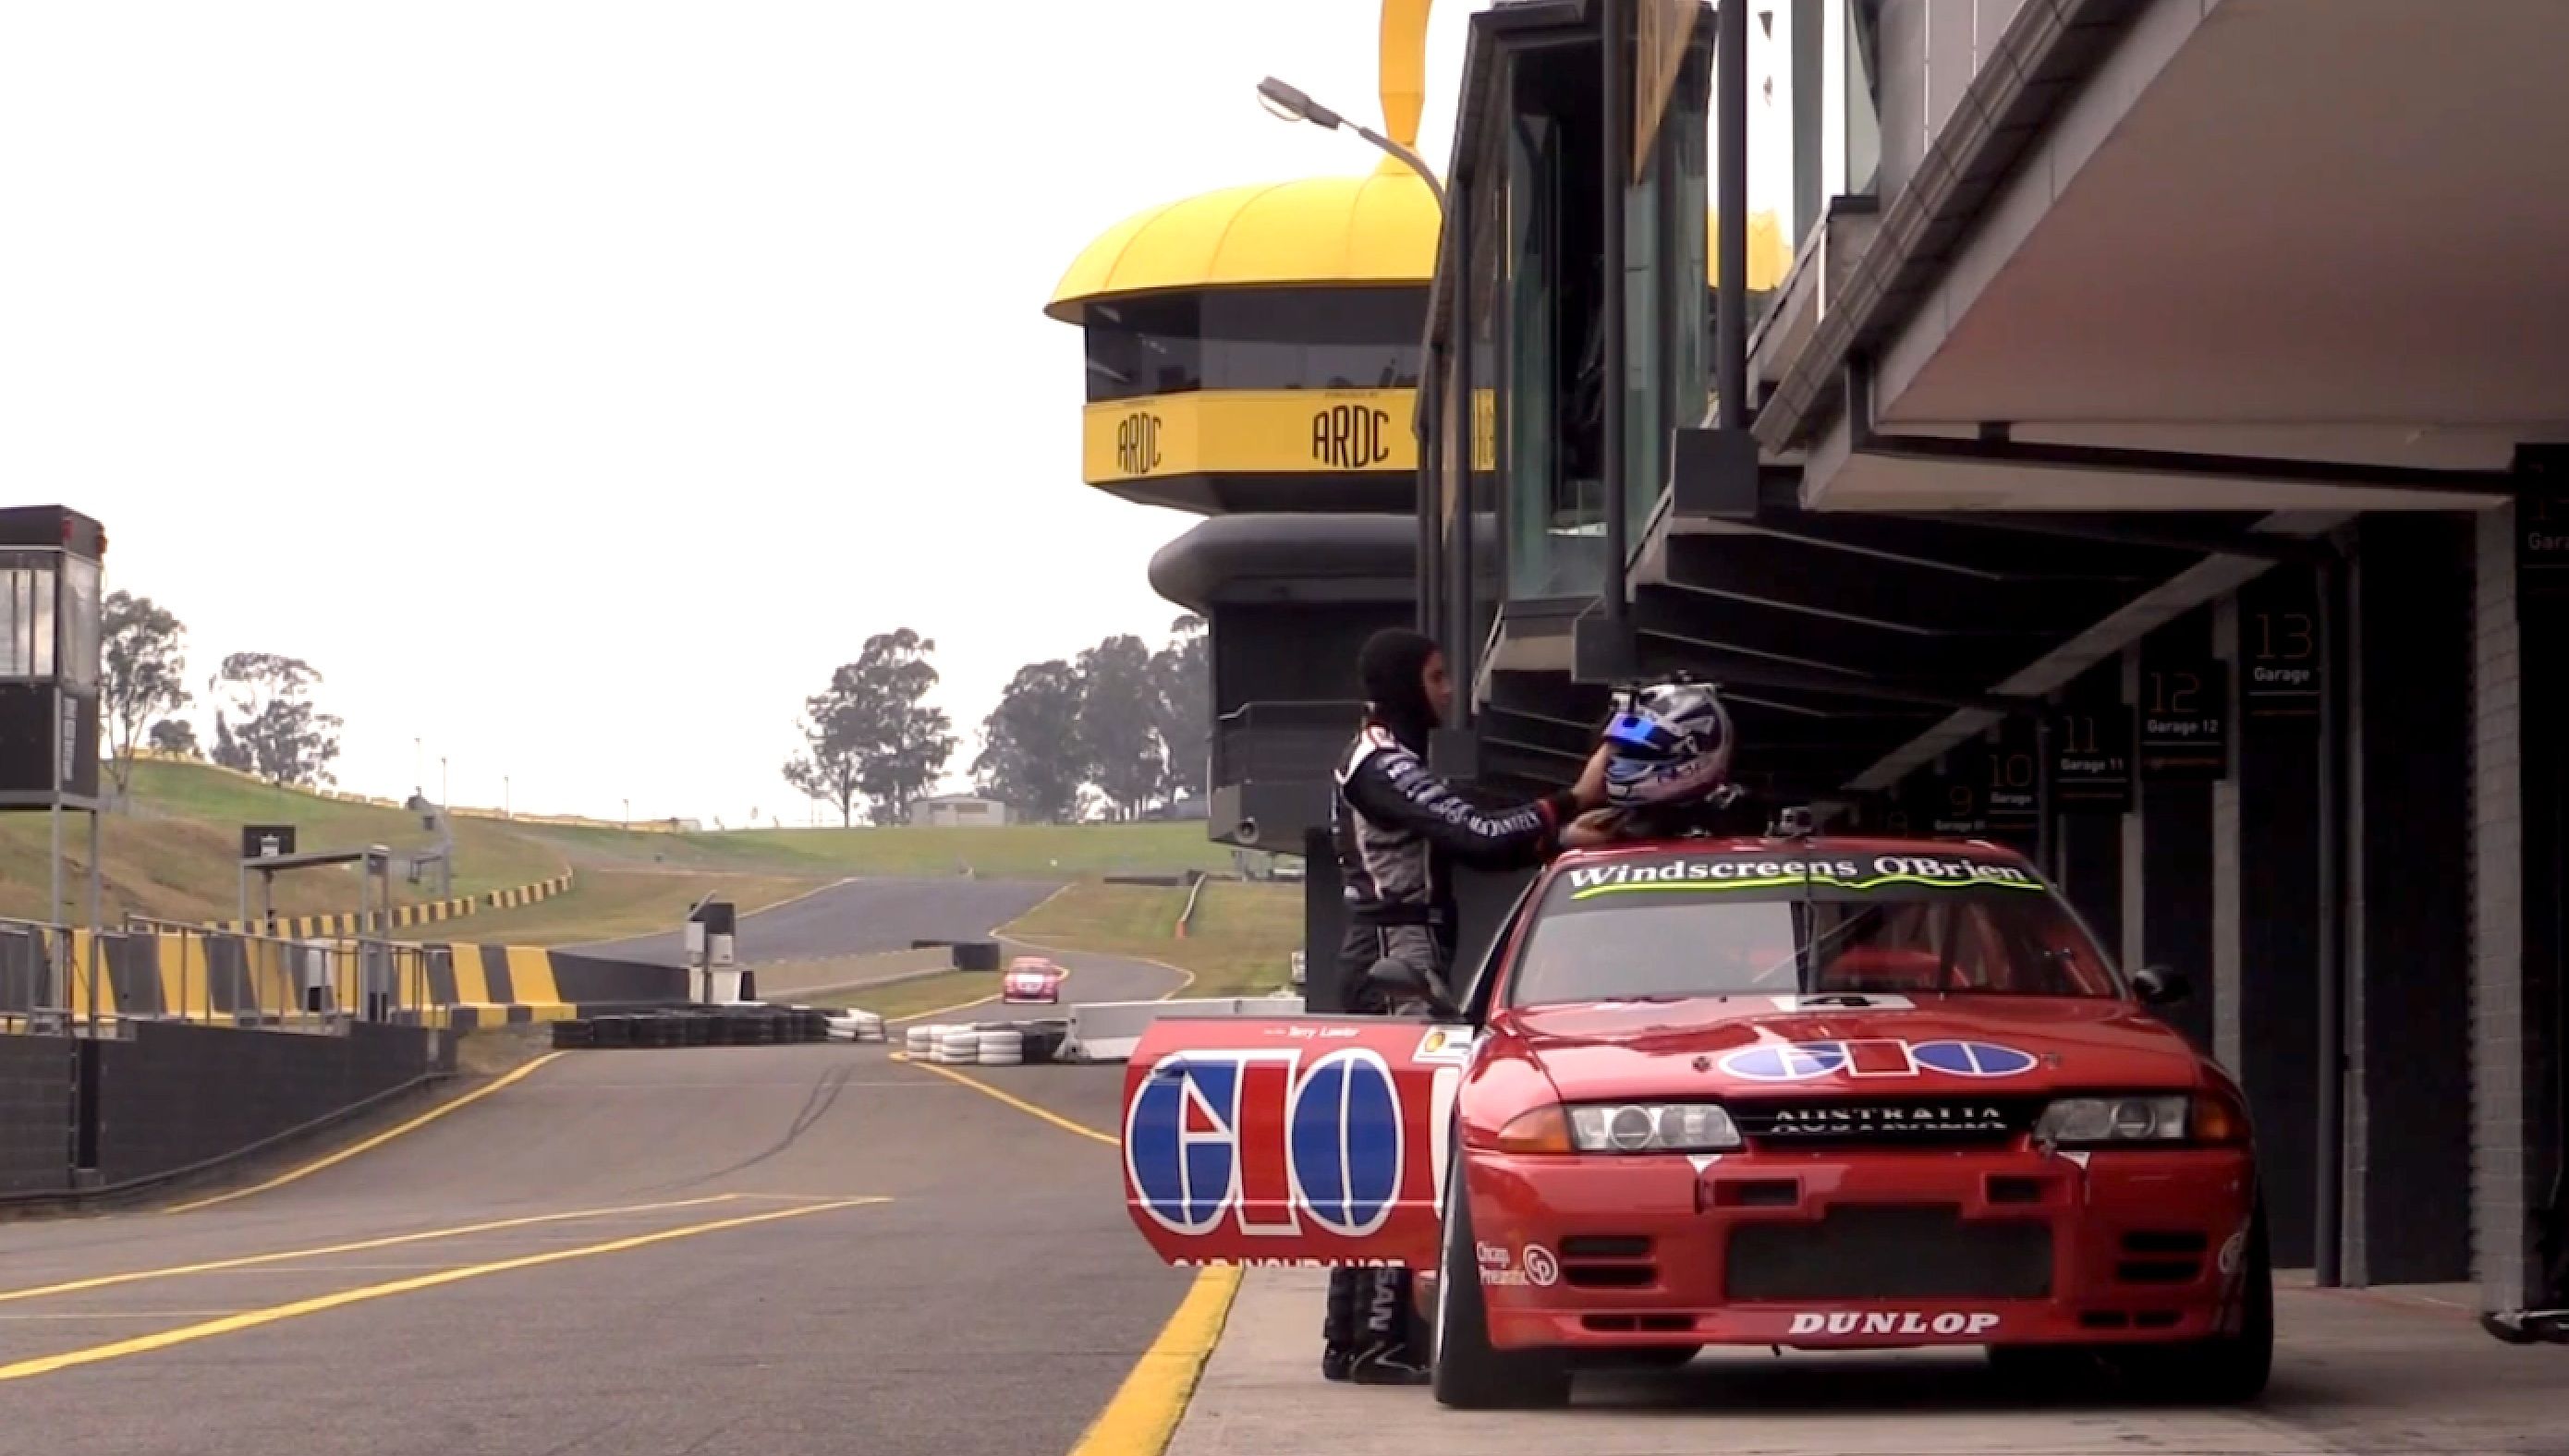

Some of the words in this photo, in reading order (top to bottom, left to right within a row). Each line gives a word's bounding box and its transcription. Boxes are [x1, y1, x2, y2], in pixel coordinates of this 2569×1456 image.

[1117, 411, 1162, 474] ARDC
[1312, 405, 1390, 468] ARDC
[2256, 613, 2313, 660] 13
[2149, 673, 2201, 713] 12
[2254, 667, 2310, 685] Garage
[2063, 715, 2100, 754] 11
[2147, 719, 2199, 736] Garage
[2202, 719, 2219, 734] 12
[1989, 754, 2032, 788] 10
[2061, 758, 2106, 774] Garage
[1571, 858, 1858, 888] Windscreens
[1874, 855, 2027, 882] O'Brien
[1719, 1038, 2038, 1081] GIO
[1771, 1107, 2007, 1134] AUSTRALIA
[1126, 1049, 1405, 1237] GIO
[1789, 1313, 2001, 1334] DUNLOP
